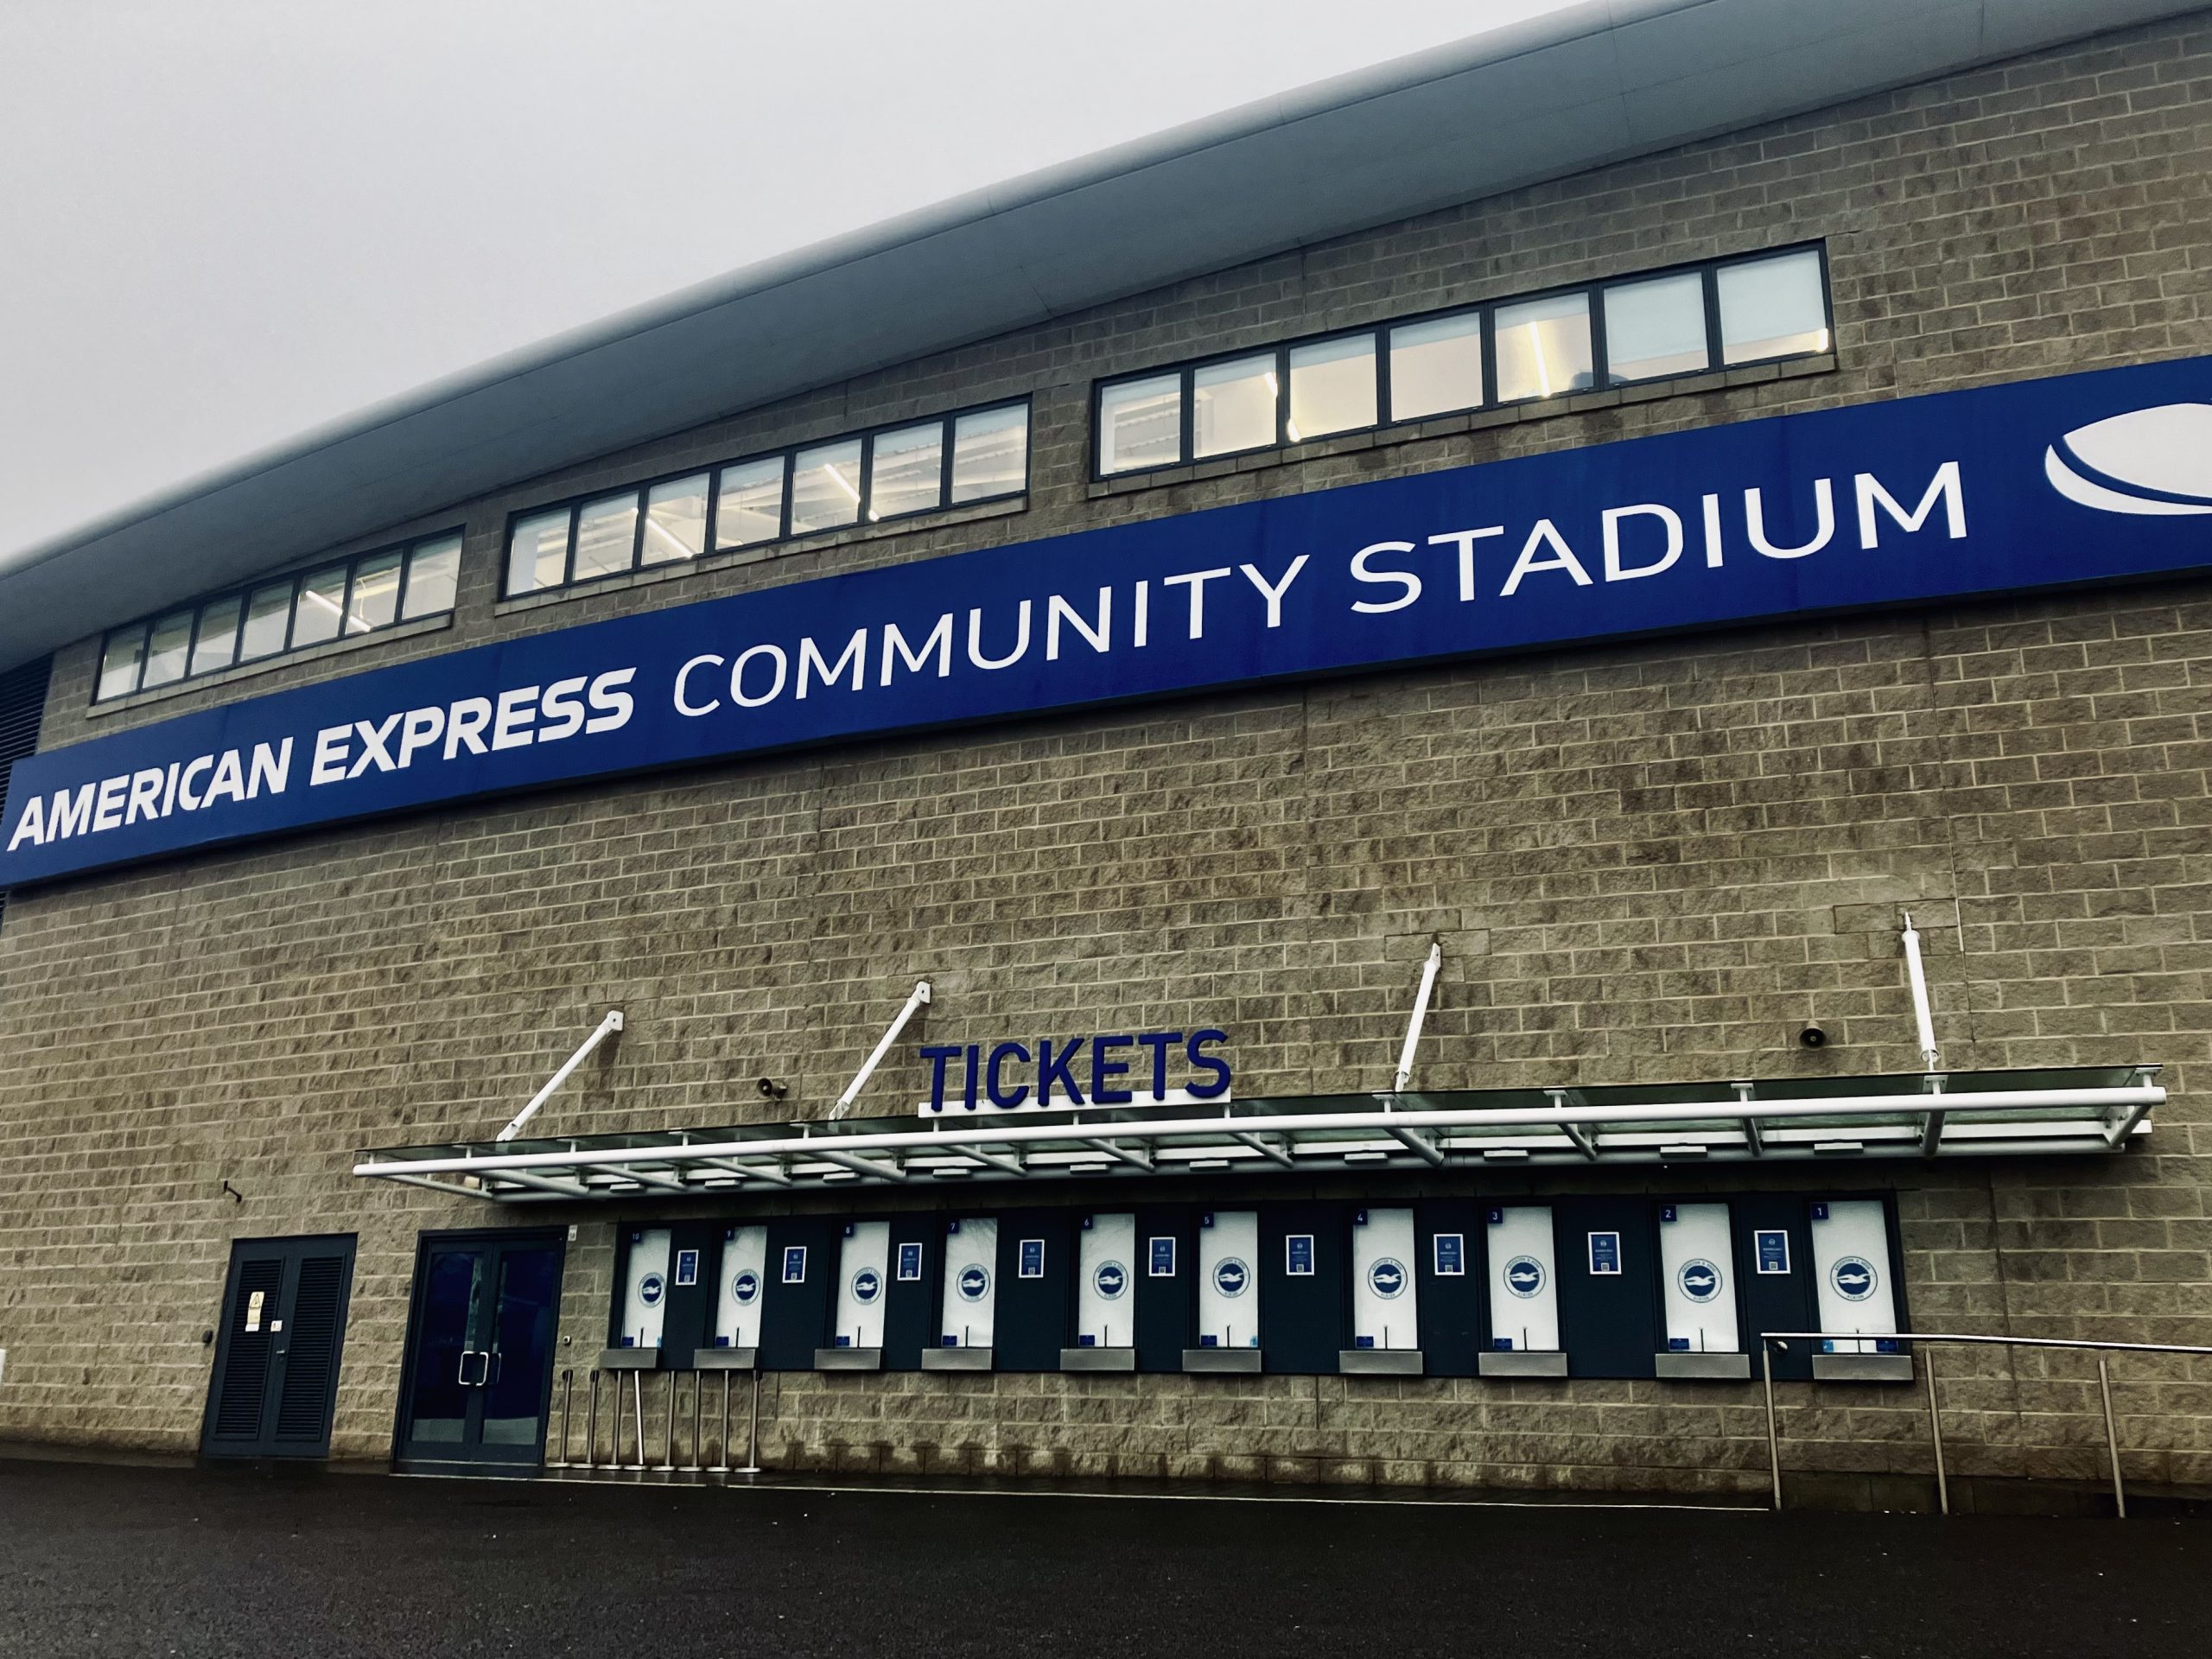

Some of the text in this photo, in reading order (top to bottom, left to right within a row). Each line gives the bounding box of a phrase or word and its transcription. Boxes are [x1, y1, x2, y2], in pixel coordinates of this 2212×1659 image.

[6, 461, 1967, 852] AMERICAN EXPRESS COMMUNITY STADIUM
[920, 1029, 1231, 1112] TICKETS
[1665, 1209, 1671, 1218] 2
